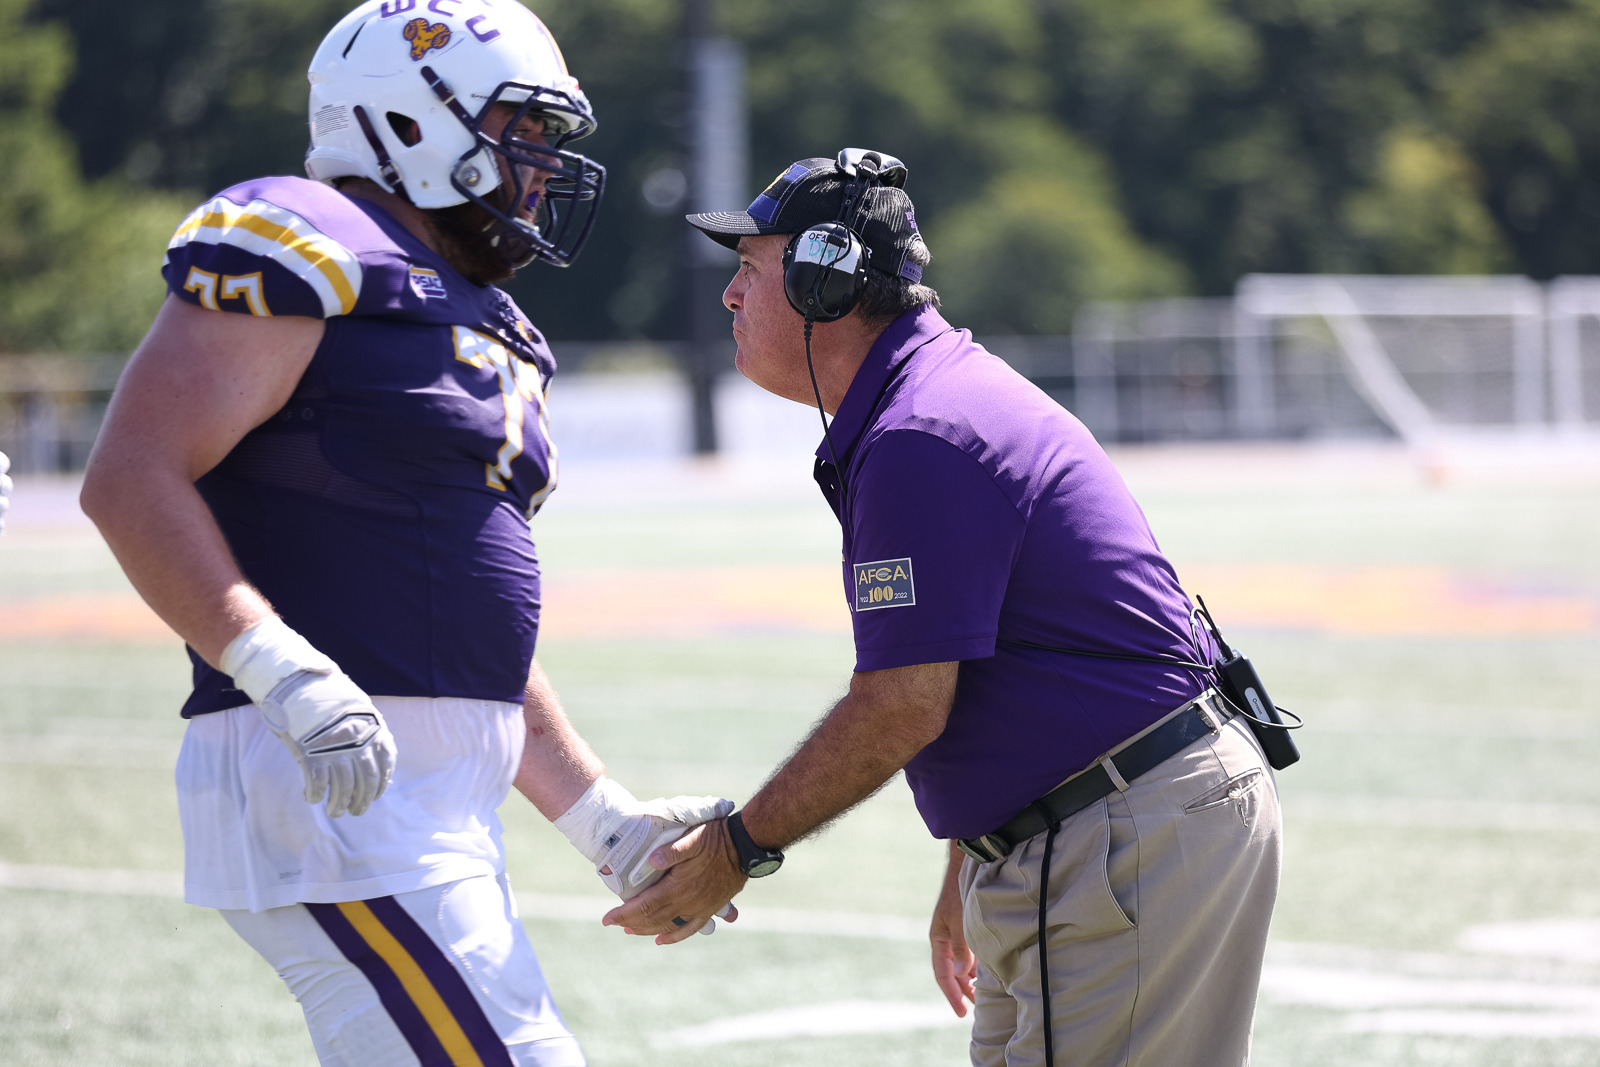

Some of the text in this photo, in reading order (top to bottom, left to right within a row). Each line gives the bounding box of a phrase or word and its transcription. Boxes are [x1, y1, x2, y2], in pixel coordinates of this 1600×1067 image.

[183, 266, 274, 317] 77
[858, 565, 907, 585] AFCA
[868, 585, 894, 603] 100
